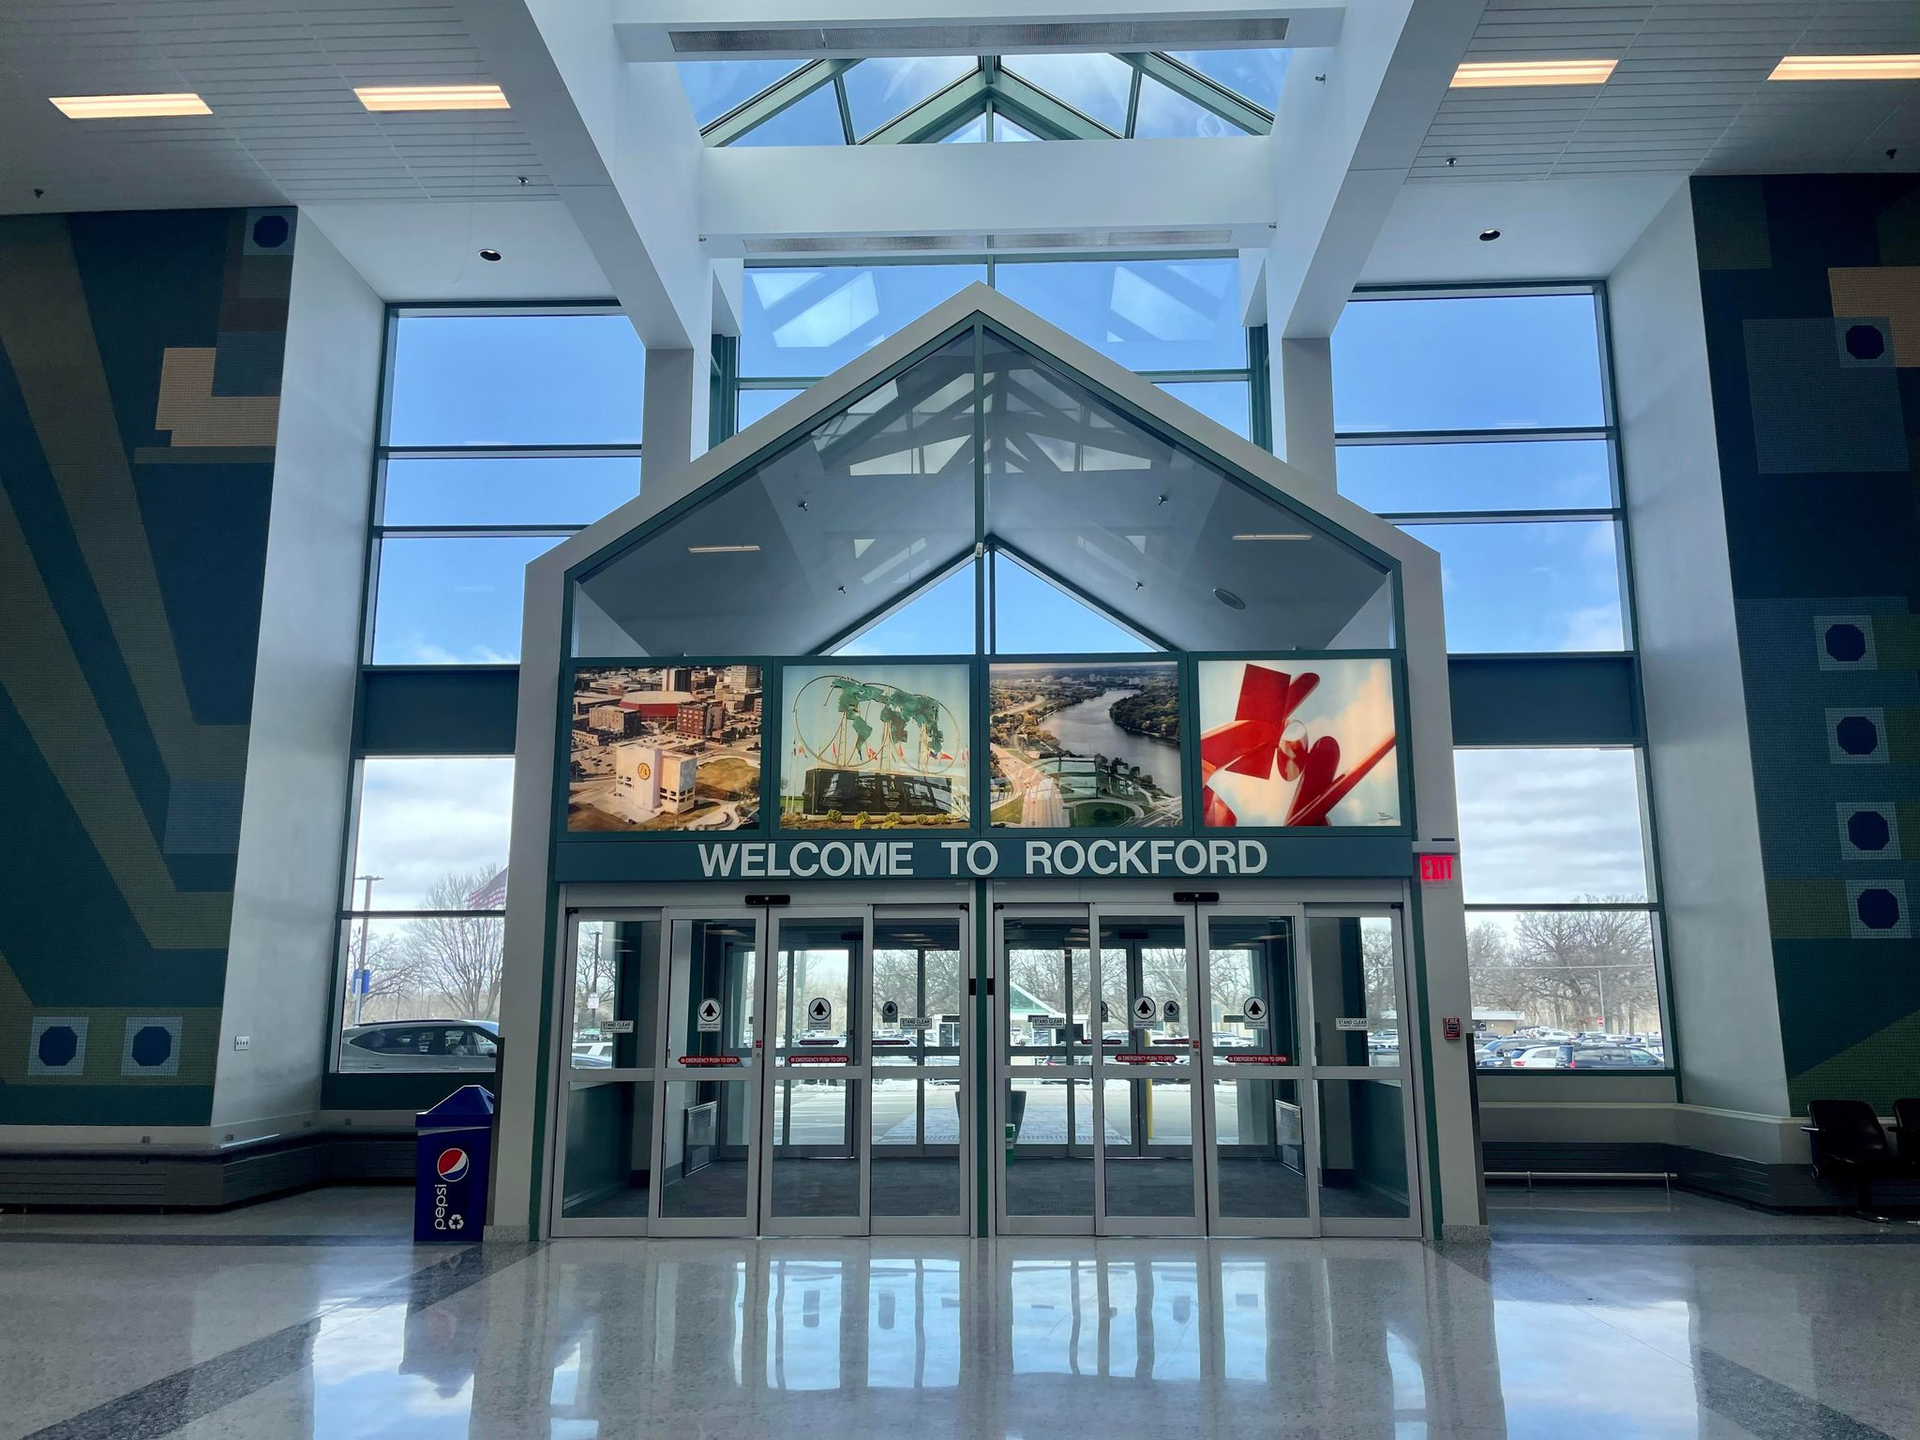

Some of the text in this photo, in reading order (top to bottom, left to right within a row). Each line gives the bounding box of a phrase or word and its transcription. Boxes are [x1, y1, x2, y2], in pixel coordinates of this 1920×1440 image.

[698, 839, 1268, 877] WELCOME TO ROCKFORD
[1420, 855, 1453, 880] EXIT
[434, 1184, 448, 1230] pepsi
